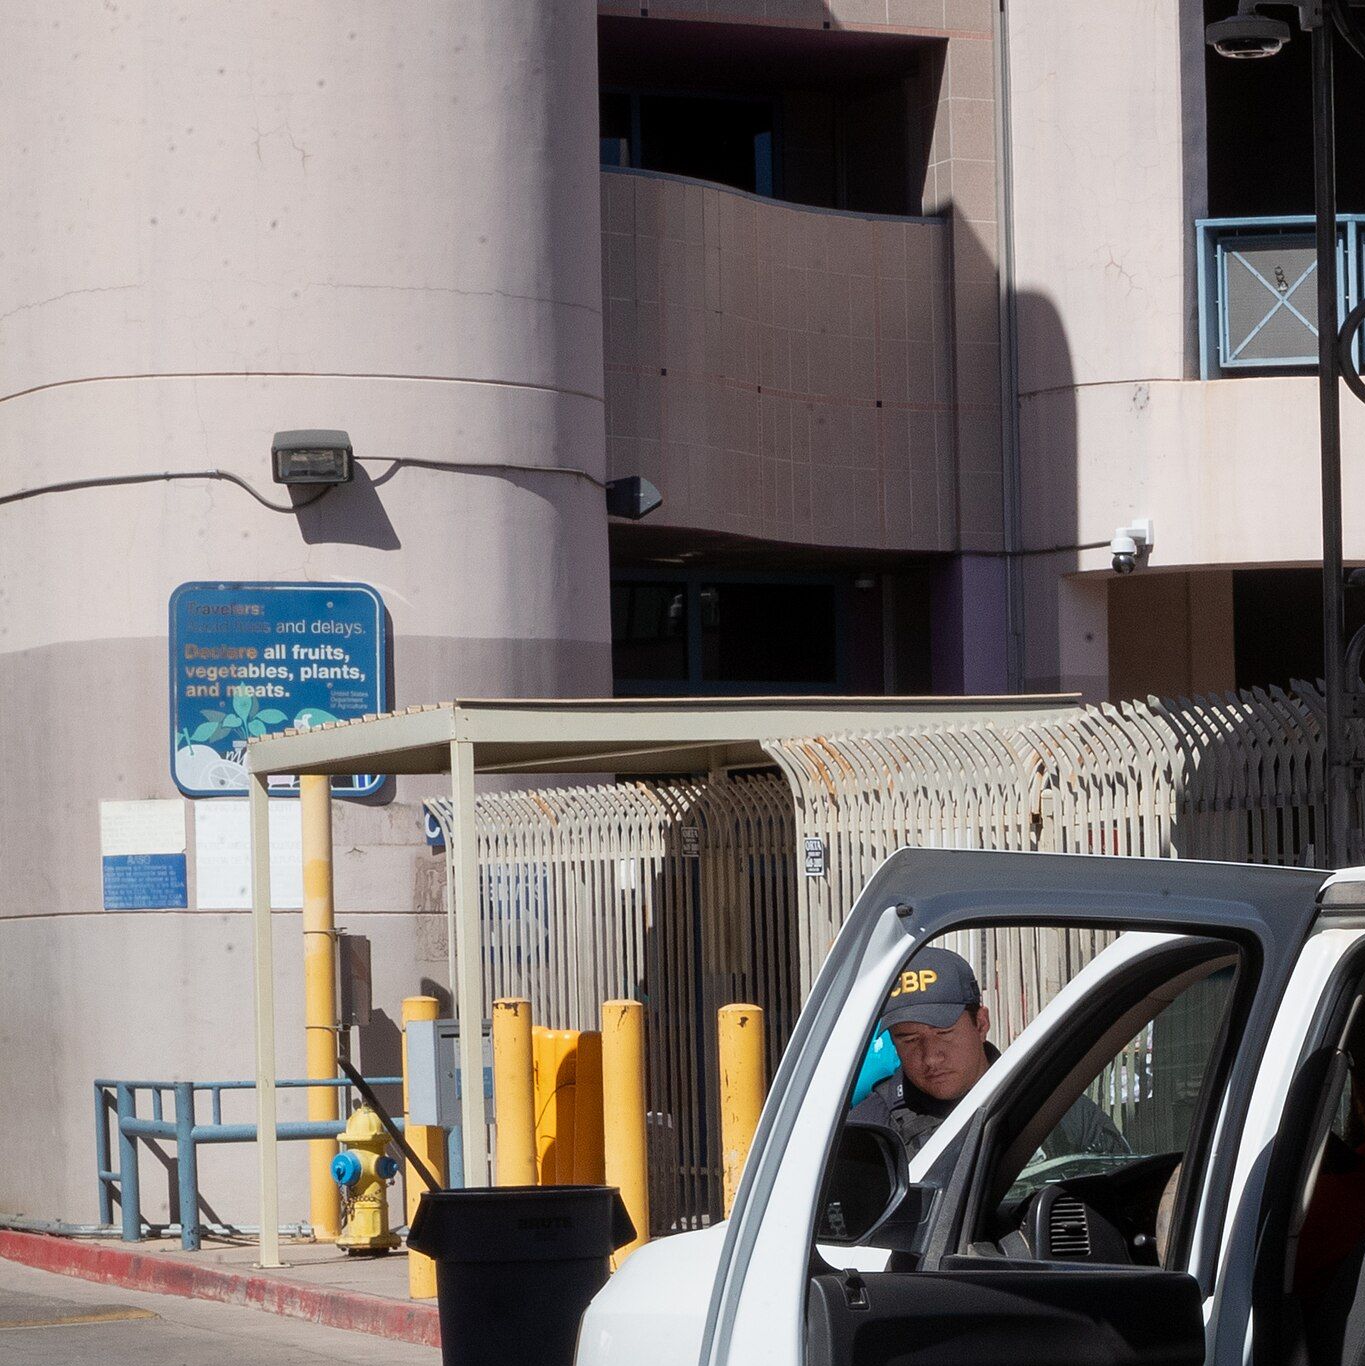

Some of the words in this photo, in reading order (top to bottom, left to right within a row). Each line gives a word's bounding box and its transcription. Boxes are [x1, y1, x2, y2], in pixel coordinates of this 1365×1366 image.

[277, 621, 305, 633] and
[311, 620, 366, 638] delays.
[185, 644, 257, 659] Declare
[264, 645, 285, 659] all
[292, 645, 350, 662] fruits,
[185, 663, 294, 681] vegetables,
[301, 664, 366, 682] plants,
[186, 683, 220, 697] and
[227, 683, 290, 697] meats.
